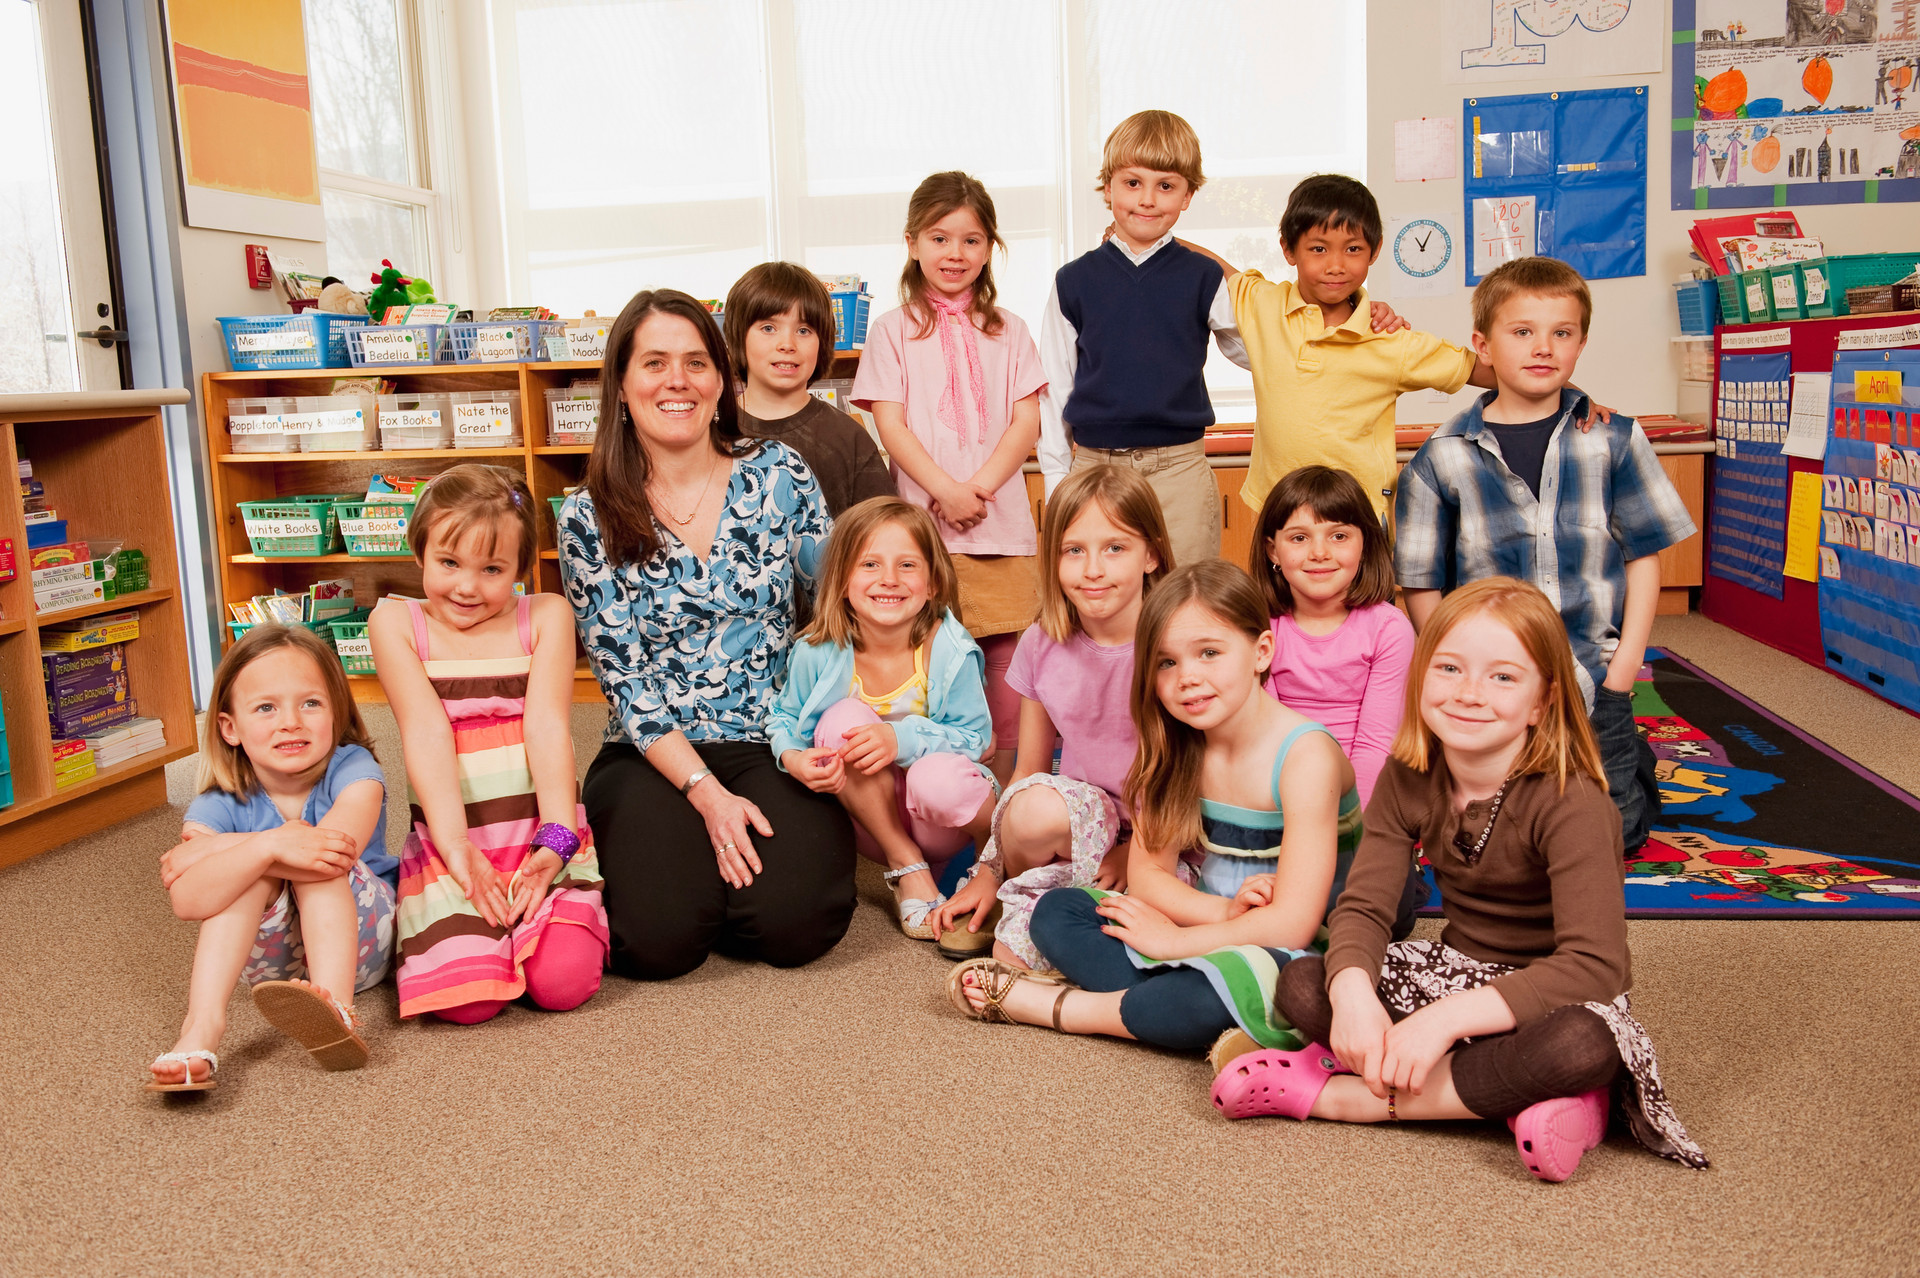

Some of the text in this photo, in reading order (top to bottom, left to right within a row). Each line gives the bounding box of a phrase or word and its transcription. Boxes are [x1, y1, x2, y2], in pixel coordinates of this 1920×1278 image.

[366, 334, 404, 344] Amelia
[480, 332, 505, 342] Black
[570, 333, 594, 344] Judy
[1850, 336, 1861, 346] many
[1863, 333, 1873, 346] days
[1875, 332, 1887, 343] have
[1906, 328, 1918, 340] this
[369, 350, 410, 360] Bedelia
[482, 348, 515, 358] Lagoon
[572, 347, 605, 358] Moody
[1870, 376, 1889, 398] April
[458, 405, 510, 417] Nate the
[230, 420, 279, 432] Poppleton
[282, 420, 313, 432] Henry
[317, 418, 323, 428] &
[380, 415, 433, 426] Fox Books
[558, 420, 591, 431] Harry
[459, 424, 492, 434] Great
[248, 523, 318, 535] White Books
[342, 521, 399, 532] Blue Books
[34, 572, 85, 587] RHYMING WORDS
[41, 597, 74, 609] COMPOUND
[338, 643, 368, 652] Green
[56, 661, 80, 675] READING
[60, 693, 83, 707] READING
